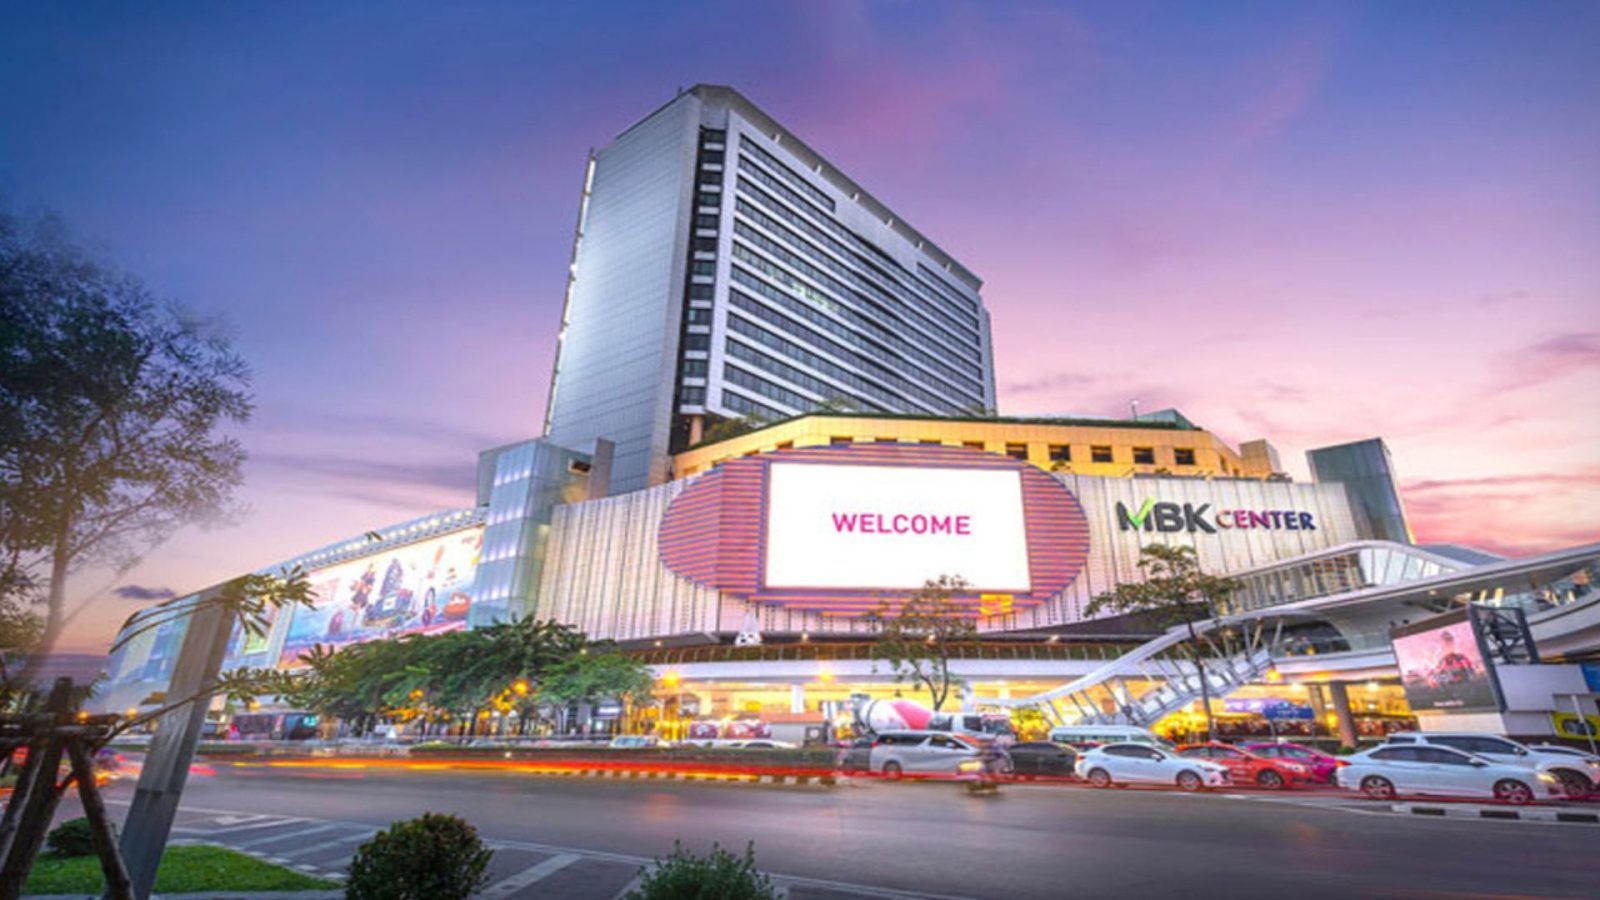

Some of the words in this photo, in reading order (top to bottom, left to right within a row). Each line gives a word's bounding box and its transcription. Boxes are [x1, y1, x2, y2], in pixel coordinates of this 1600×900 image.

[832, 512, 971, 536] WELCOME
[1116, 497, 1217, 533] MBK
[1215, 509, 1316, 530] CENTER
